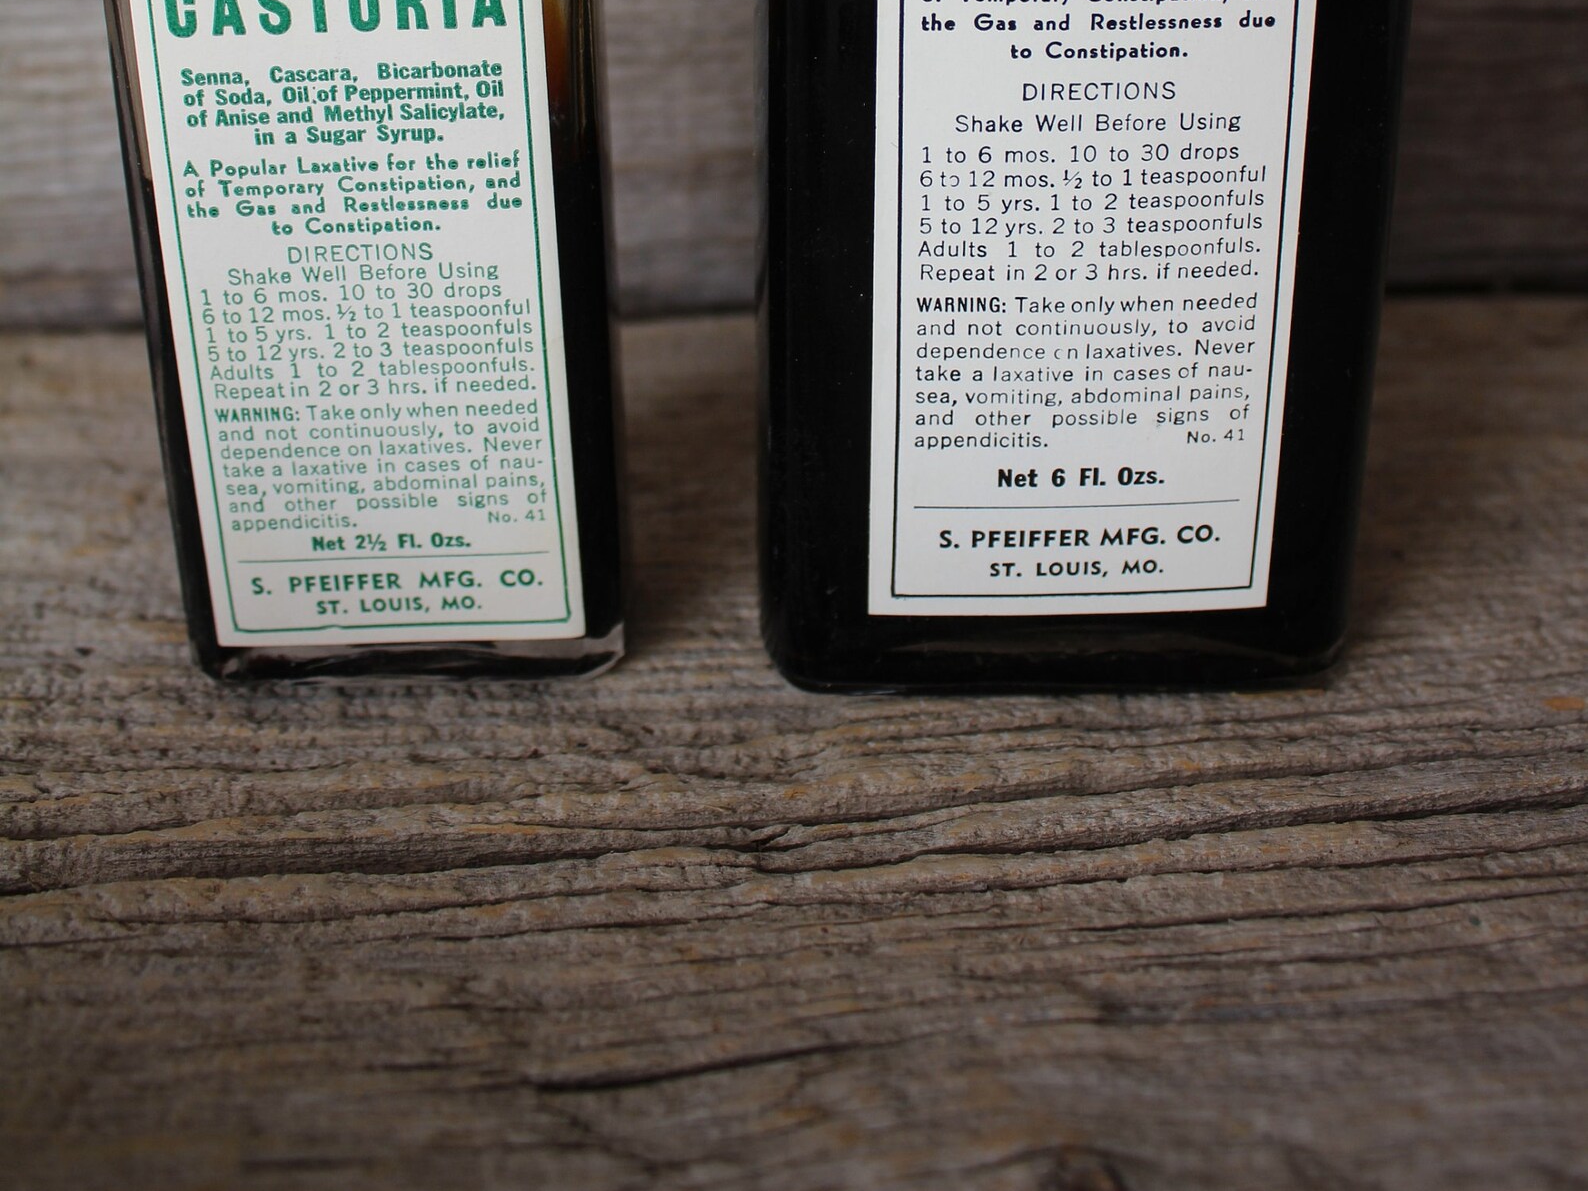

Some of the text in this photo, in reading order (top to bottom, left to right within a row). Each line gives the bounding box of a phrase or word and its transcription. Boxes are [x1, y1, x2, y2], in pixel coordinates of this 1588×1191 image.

[922, 10, 1275, 31] the Gas and Restlessness due
[1011, 41, 1188, 62] to Constipation.
[180, 60, 502, 87] Senna, Cascara, Bicarbonate
[1023, 81, 1175, 101] DIRECTIONS
[186, 102, 504, 127] of Anise and Methyl Salicylate,
[956, 113, 1241, 132] Shake Well Before Using
[254, 126, 444, 146] in a Sugar Syrup.
[184, 149, 519, 179] A Popular Laxative for the relief
[187, 170, 520, 199] of Temporary Constipation, and
[189, 192, 522, 218] the Gas and Restlessness due
[271, 216, 441, 236] to Constipation.
[288, 242, 433, 264] DIRECTIONS
[228, 262, 499, 286] Shake Well Before Using
[921, 259, 1258, 283] Repeat in 2 or 3 hrs. if needed.
[917, 292, 1257, 315] WARNING: Take only when needed
[916, 384, 1249, 407] sea, vomiting, abdominal pains,
[216, 398, 538, 423] WARNING: Take only when needed
[219, 416, 539, 441] and not continuously, to avoid
[1187, 429, 1244, 444] No. 41
[221, 437, 542, 461] dependence on laxatives. Never
[915, 432, 1048, 450] appendicitis.
[998, 467, 1164, 487] Net 6 Fl. Ozs.
[232, 515, 357, 532] appendicitis.
[488, 509, 545, 523] No. 41
[311, 536, 346, 552] Net
[397, 533, 422, 549] Fl.
[430, 532, 471, 548] Ozs.
[940, 524, 1220, 549] S. PFEIFFER MFG. CO.
[990, 559, 1163, 577] ST. LOUIS, MO.
[251, 569, 543, 595] S. PFEIFFER MFG. CO.
[316, 596, 481, 616] ST. LOUIS, MO.
